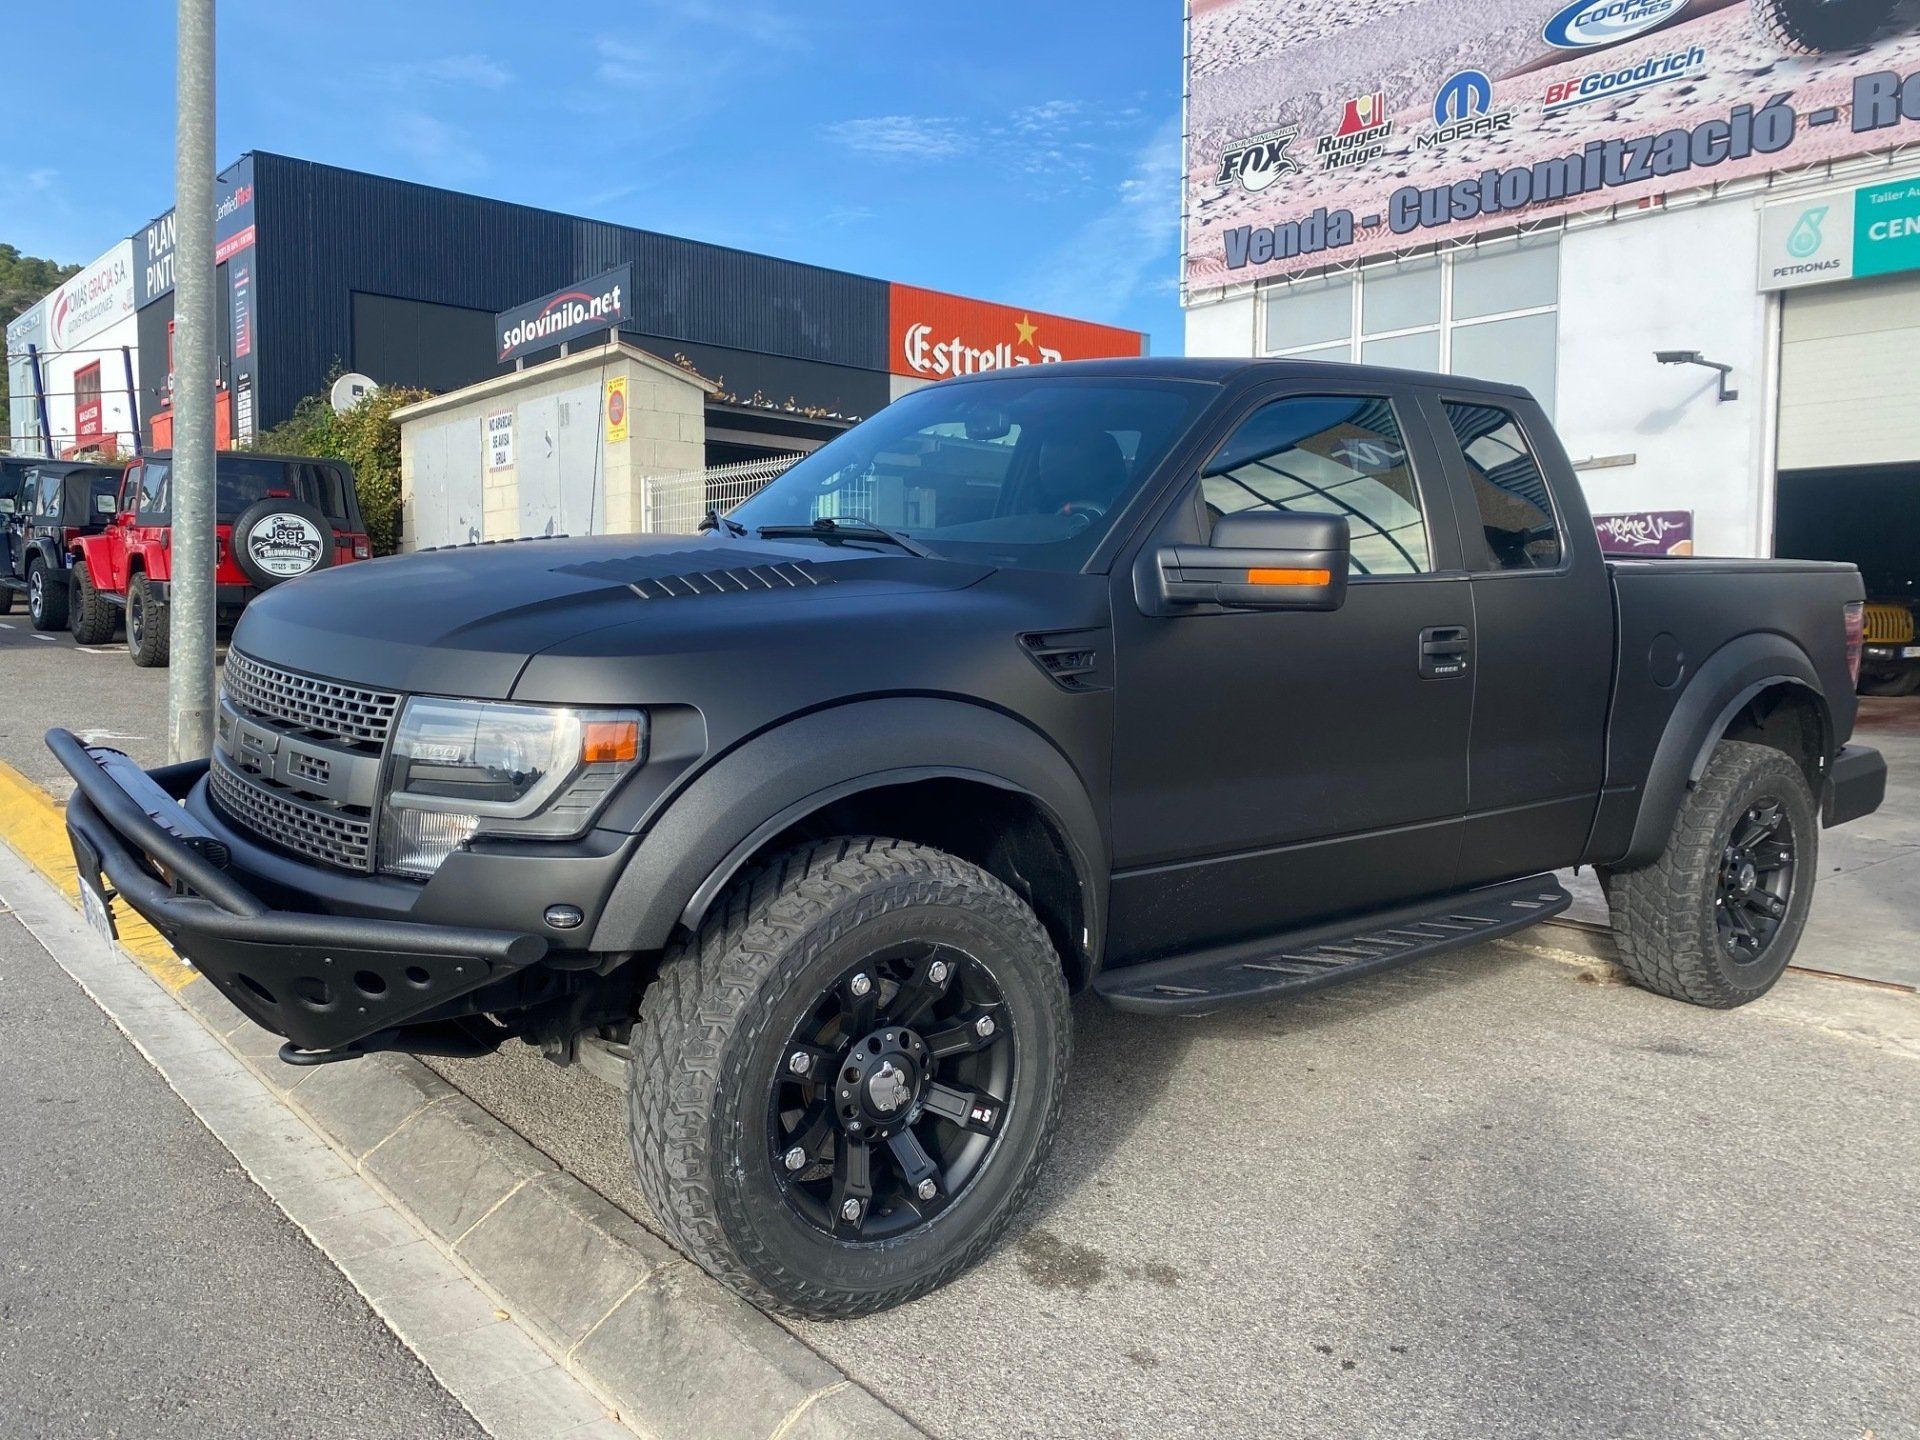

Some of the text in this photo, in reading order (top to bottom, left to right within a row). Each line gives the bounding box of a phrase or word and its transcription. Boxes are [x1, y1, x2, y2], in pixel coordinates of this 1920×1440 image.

[1575, 0, 1661, 27] COOP
[1622, 0, 1672, 23] TIRES
[1545, 47, 1705, 105] BFGoodrich
[1317, 120, 1392, 155] Rugged
[1417, 112, 1511, 150] MOPAR
[1217, 138, 1293, 182] FOX
[1325, 145, 1382, 170] Ridge
[1223, 207, 1354, 270] Venda
[1388, 90, 1797, 236] Customització
[1869, 191, 1904, 204] Taller
[1868, 215, 1920, 241] CEN
[1773, 258, 1841, 278] PETRONAS
[503, 284, 621, 349] solovinilo.net
[265, 526, 306, 543] Jeep
